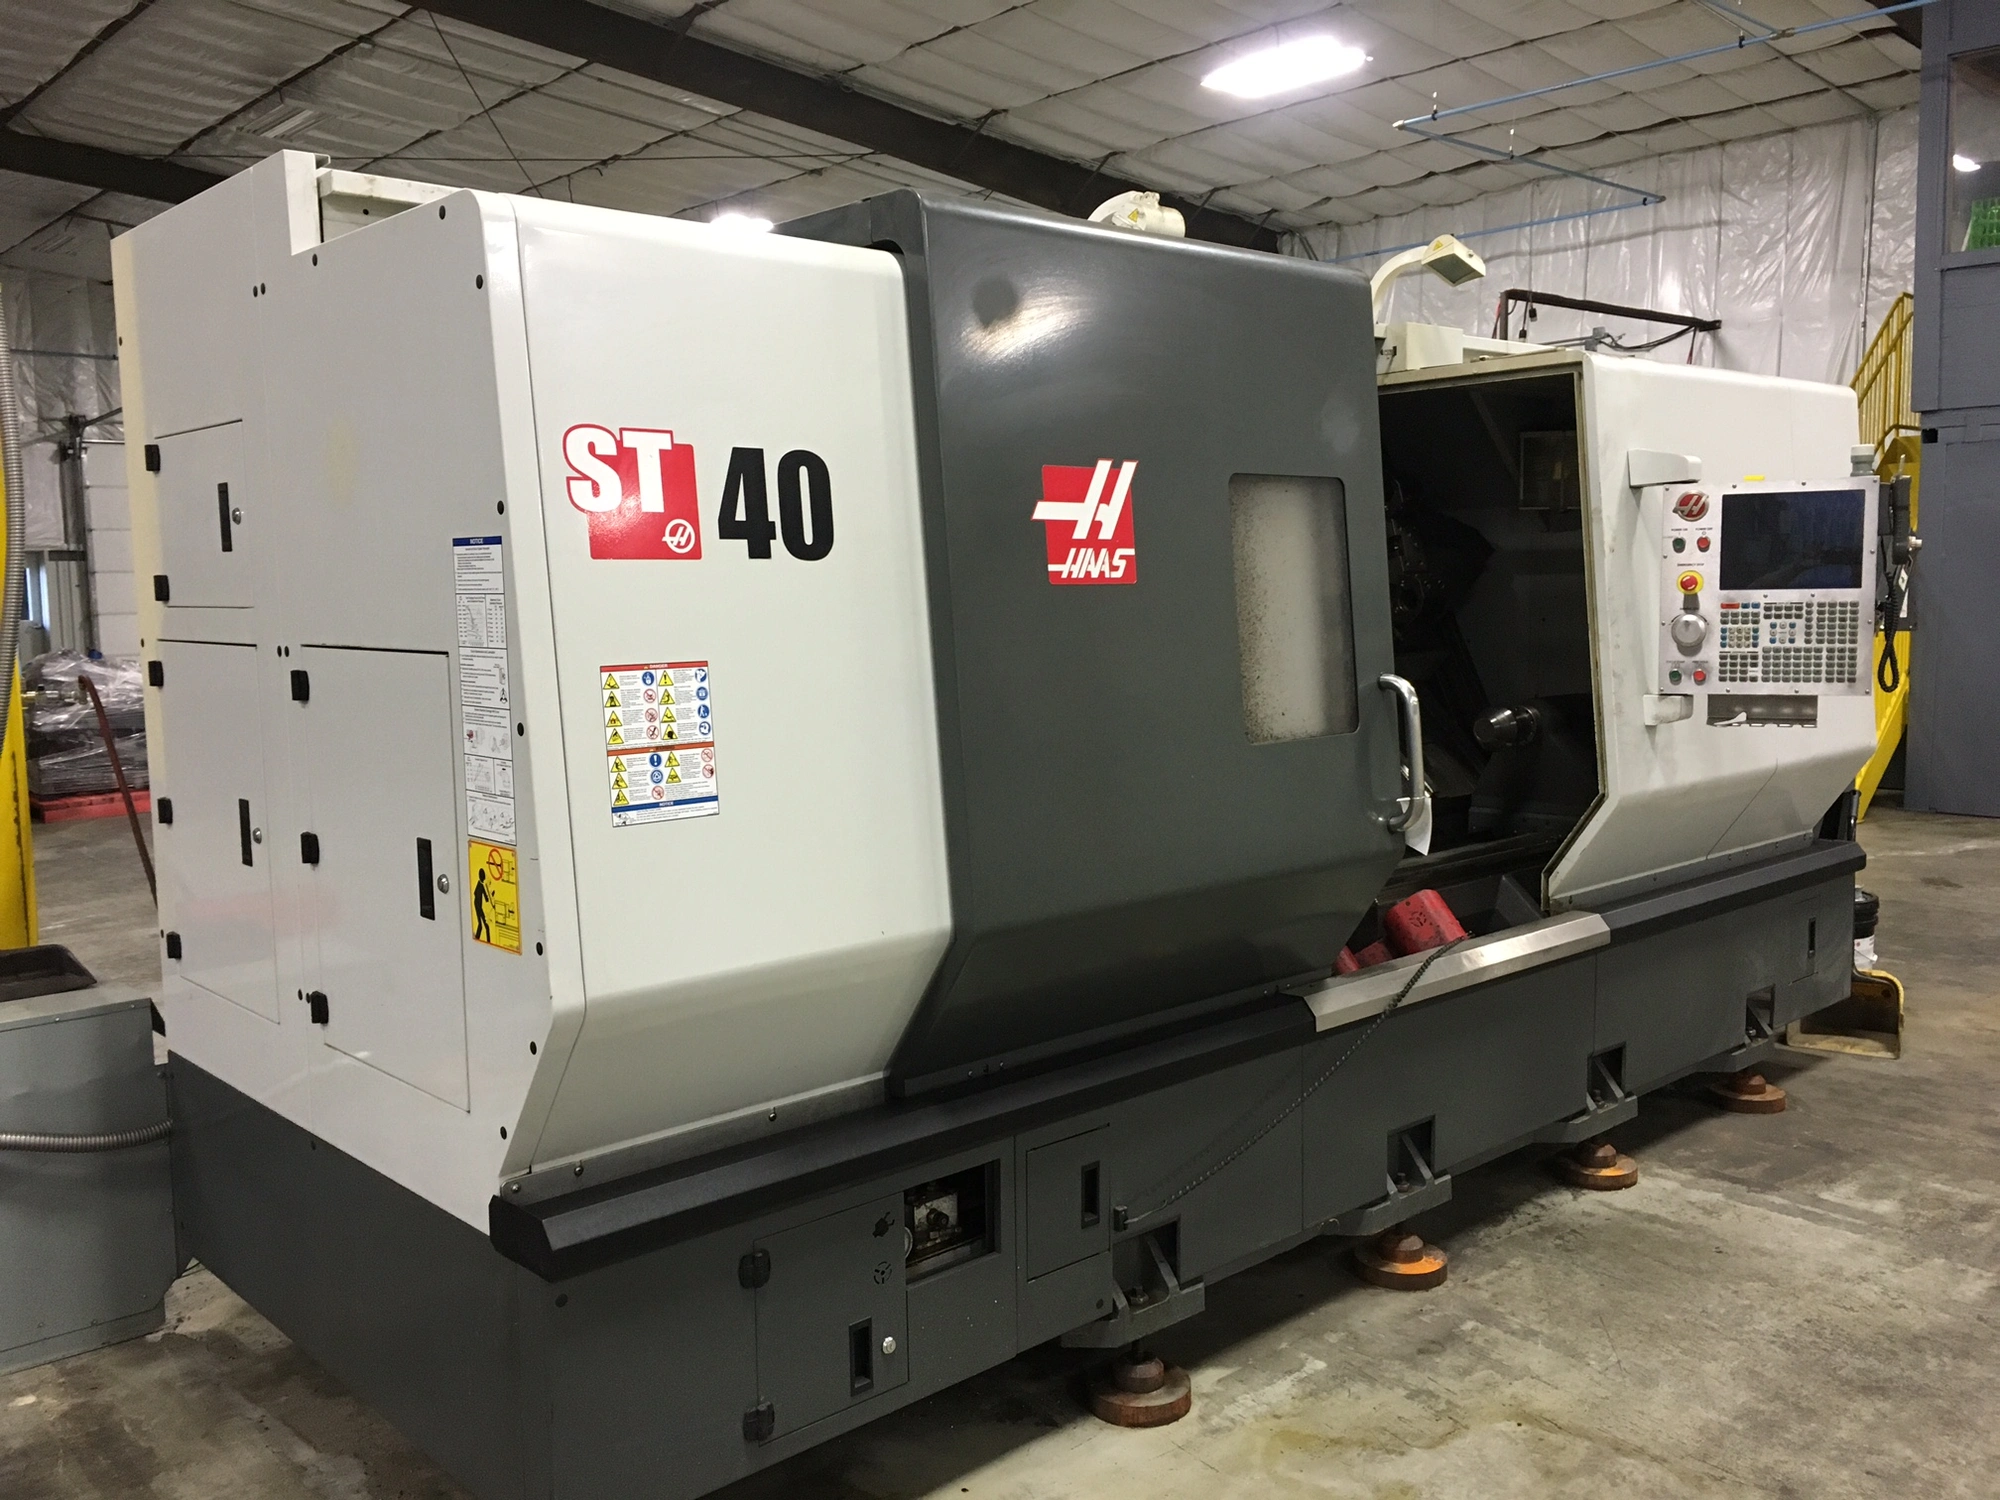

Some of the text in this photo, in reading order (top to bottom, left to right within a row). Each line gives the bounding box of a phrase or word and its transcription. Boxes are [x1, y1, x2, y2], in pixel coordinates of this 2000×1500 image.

[562, 423, 834, 561] ST 40
[1047, 547, 1136, 579] HAAS
